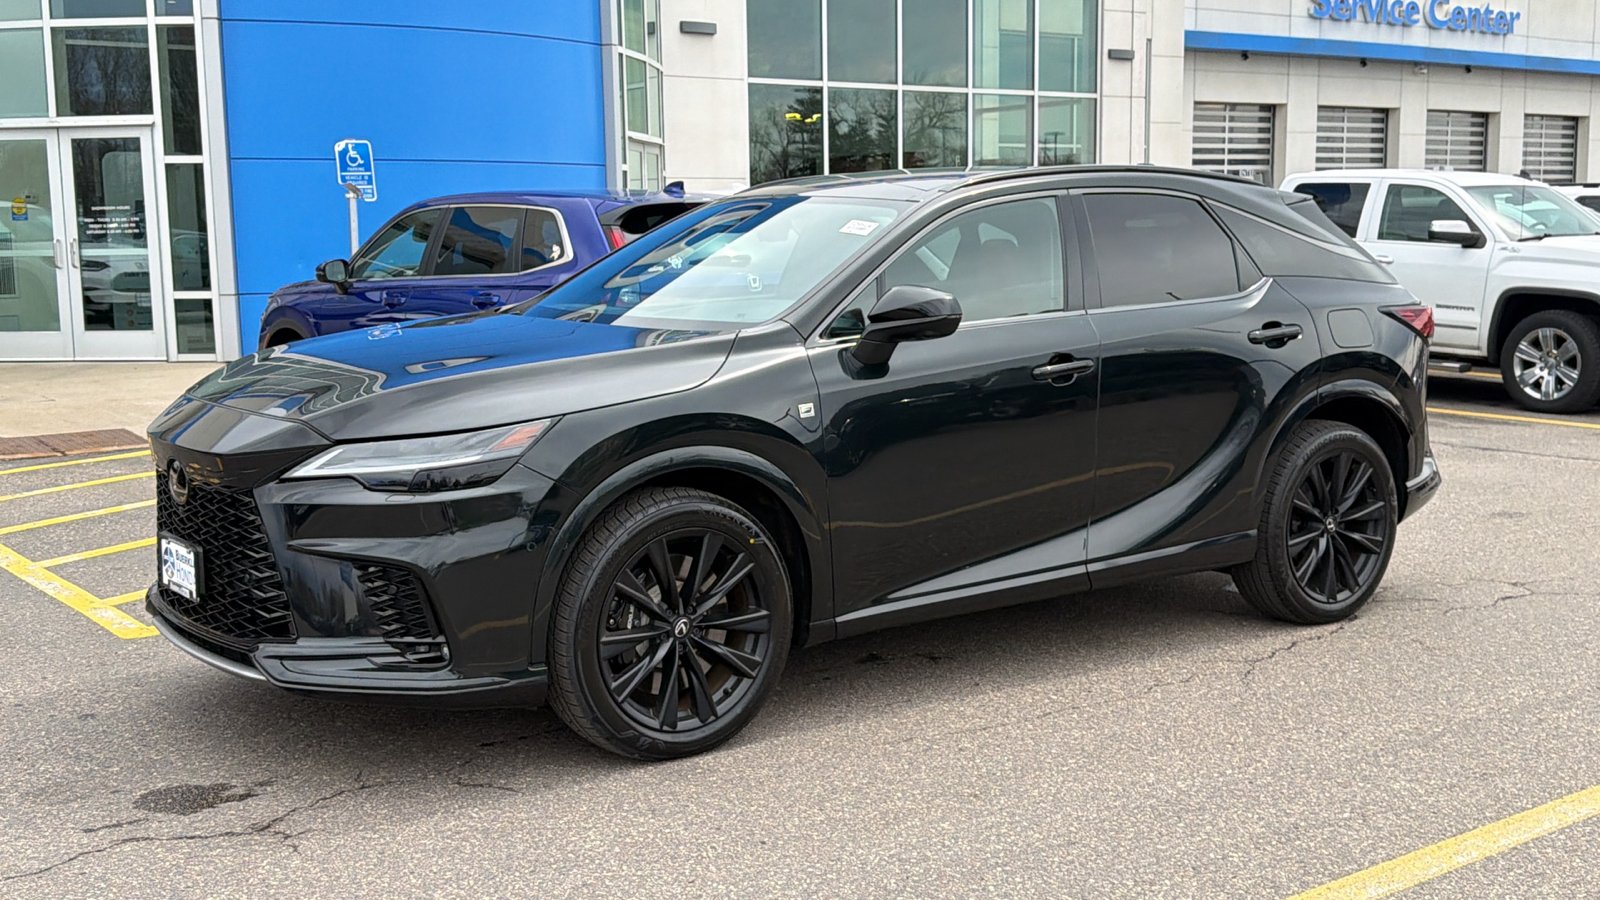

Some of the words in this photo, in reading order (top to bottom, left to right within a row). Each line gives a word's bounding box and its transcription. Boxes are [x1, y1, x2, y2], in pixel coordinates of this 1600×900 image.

[1309, 0, 1420, 25] Service
[1425, 0, 1520, 34] Center
[175, 549, 195, 568] BUERKL
[176, 561, 195, 586] HOND
